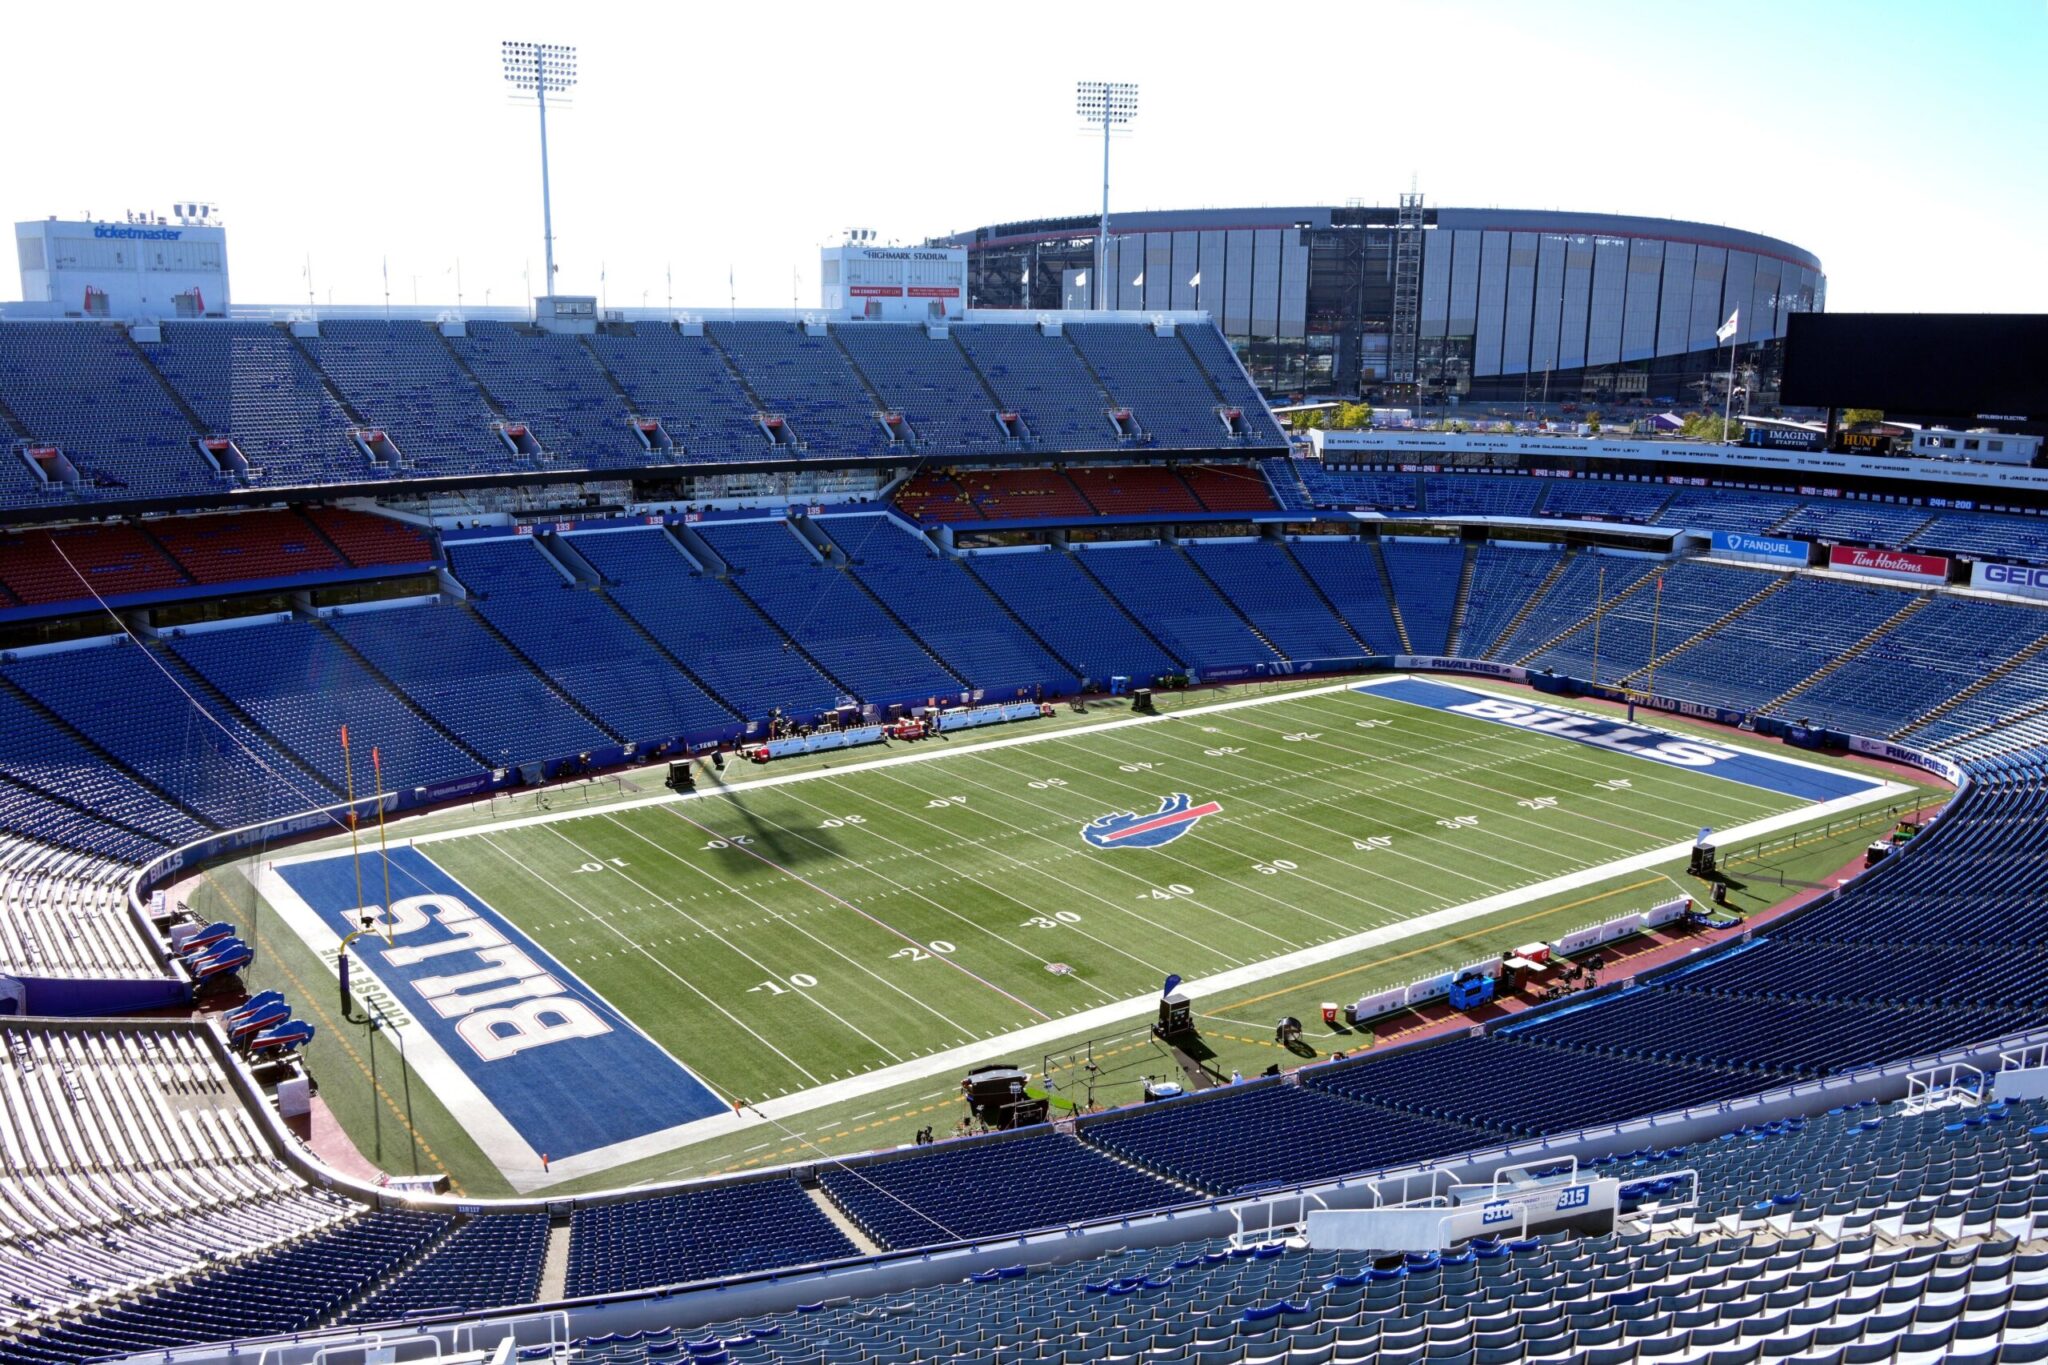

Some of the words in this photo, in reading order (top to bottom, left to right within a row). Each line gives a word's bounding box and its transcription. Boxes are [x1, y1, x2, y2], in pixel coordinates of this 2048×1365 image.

[94, 225, 182, 241] ticketmaster
[868, 250, 911, 260] HIGHMARK
[914, 252, 948, 261] STADIUM
[1769, 430, 1817, 441] IMAGINE
[1843, 433, 1879, 447] HUNT
[807, 507, 821, 515] 135
[1929, 498, 1946, 507] 244
[1954, 500, 1971, 509] 200
[650, 516, 664, 525] 133
[684, 514, 699, 522] 134
[518, 526, 533, 535] 132
[555, 522, 571, 532] 133
[1743, 539, 1791, 555] FANDUEL
[1852, 551, 1873, 566] Tim
[1875, 553, 1923, 573] Hortons
[1431, 659, 1500, 673] RIVALRIES
[1679, 703, 1718, 720] BILLS
[1282, 731, 1318, 743] 20
[1446, 699, 1731, 766] BILLS
[1204, 745, 1241, 757] 30
[1119, 760, 1155, 774] 40
[1886, 744, 1949, 776] RIVALRIES
[1027, 777, 1068, 790] 50
[1592, 779, 1631, 792] 10
[930, 794, 967, 808] 40
[1517, 796, 1557, 810] 20
[235, 813, 331, 846] RIVALRIES
[823, 814, 867, 829] 30
[1437, 815, 1479, 830] 30
[706, 834, 755, 851] 20
[1352, 836, 1387, 853] 40
[151, 852, 184, 880] BILLS
[580, 857, 630, 873] 10
[1252, 858, 1298, 876] 50
[1149, 883, 1195, 901] 40
[1031, 910, 1081, 929] 30
[902, 939, 957, 963] 20
[340, 894, 614, 1063] BILLS
[759, 972, 818, 997] 10
[349, 976, 411, 1029] CHOOSE
[1325, 1010, 1334, 1018] G
[1559, 1188, 1586, 1207] 315
[1485, 1202, 1512, 1221] 316
